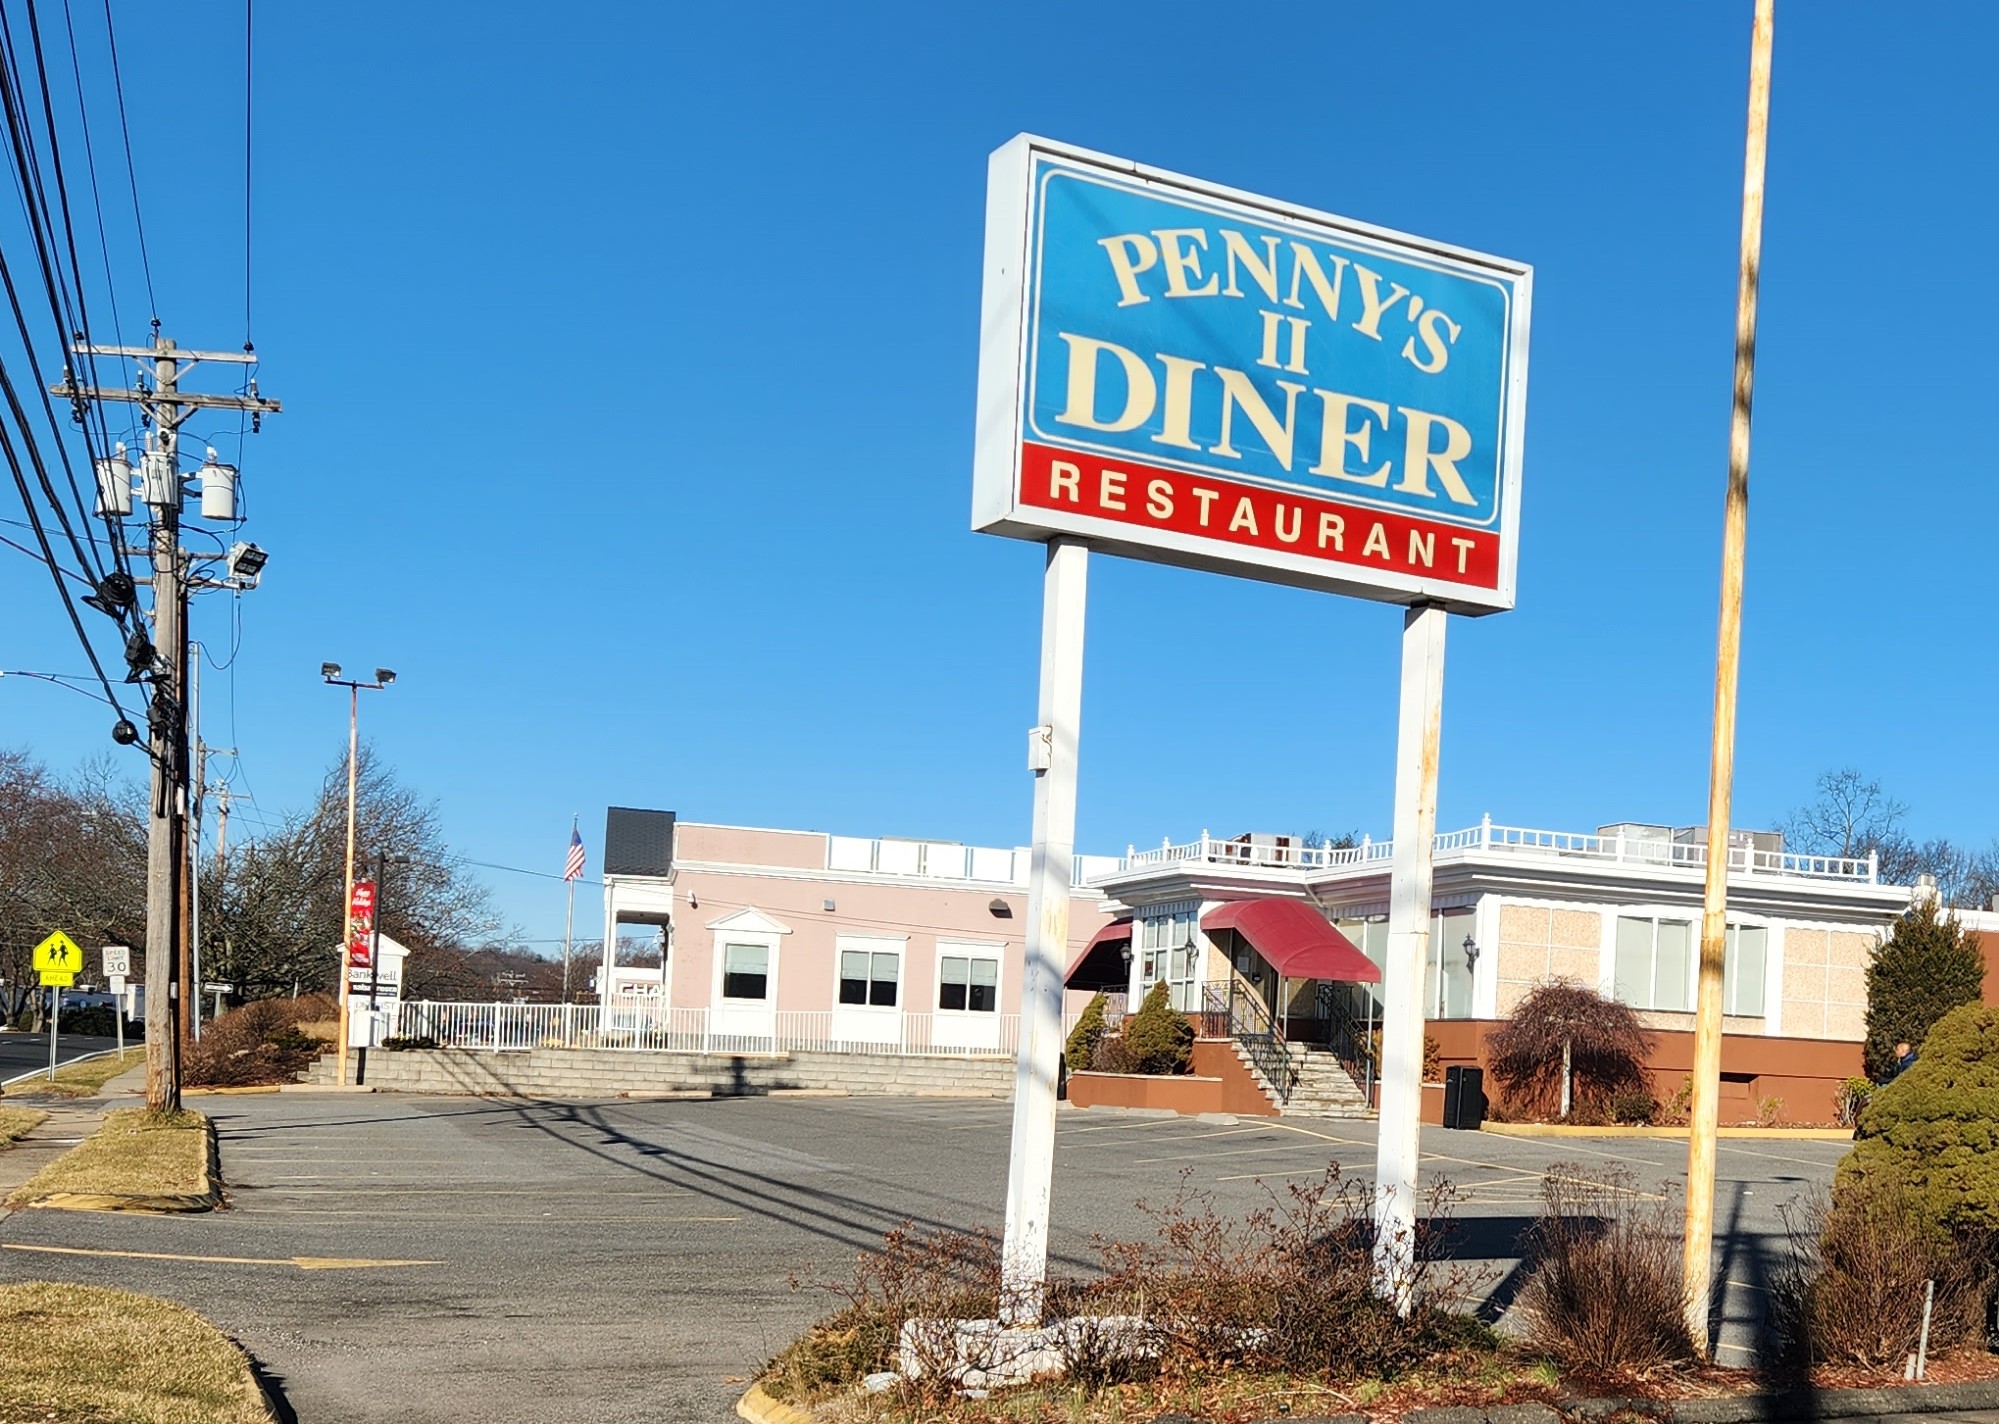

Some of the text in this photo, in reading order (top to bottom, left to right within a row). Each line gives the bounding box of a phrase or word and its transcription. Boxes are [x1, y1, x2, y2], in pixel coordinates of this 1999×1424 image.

[1097, 228, 1462, 375] PENNY'S
[1256, 309, 1311, 376] II
[1055, 331, 1478, 507] DINER
[1050, 460, 1476, 575] RESTAURANT
[107, 962, 126, 972] 30
